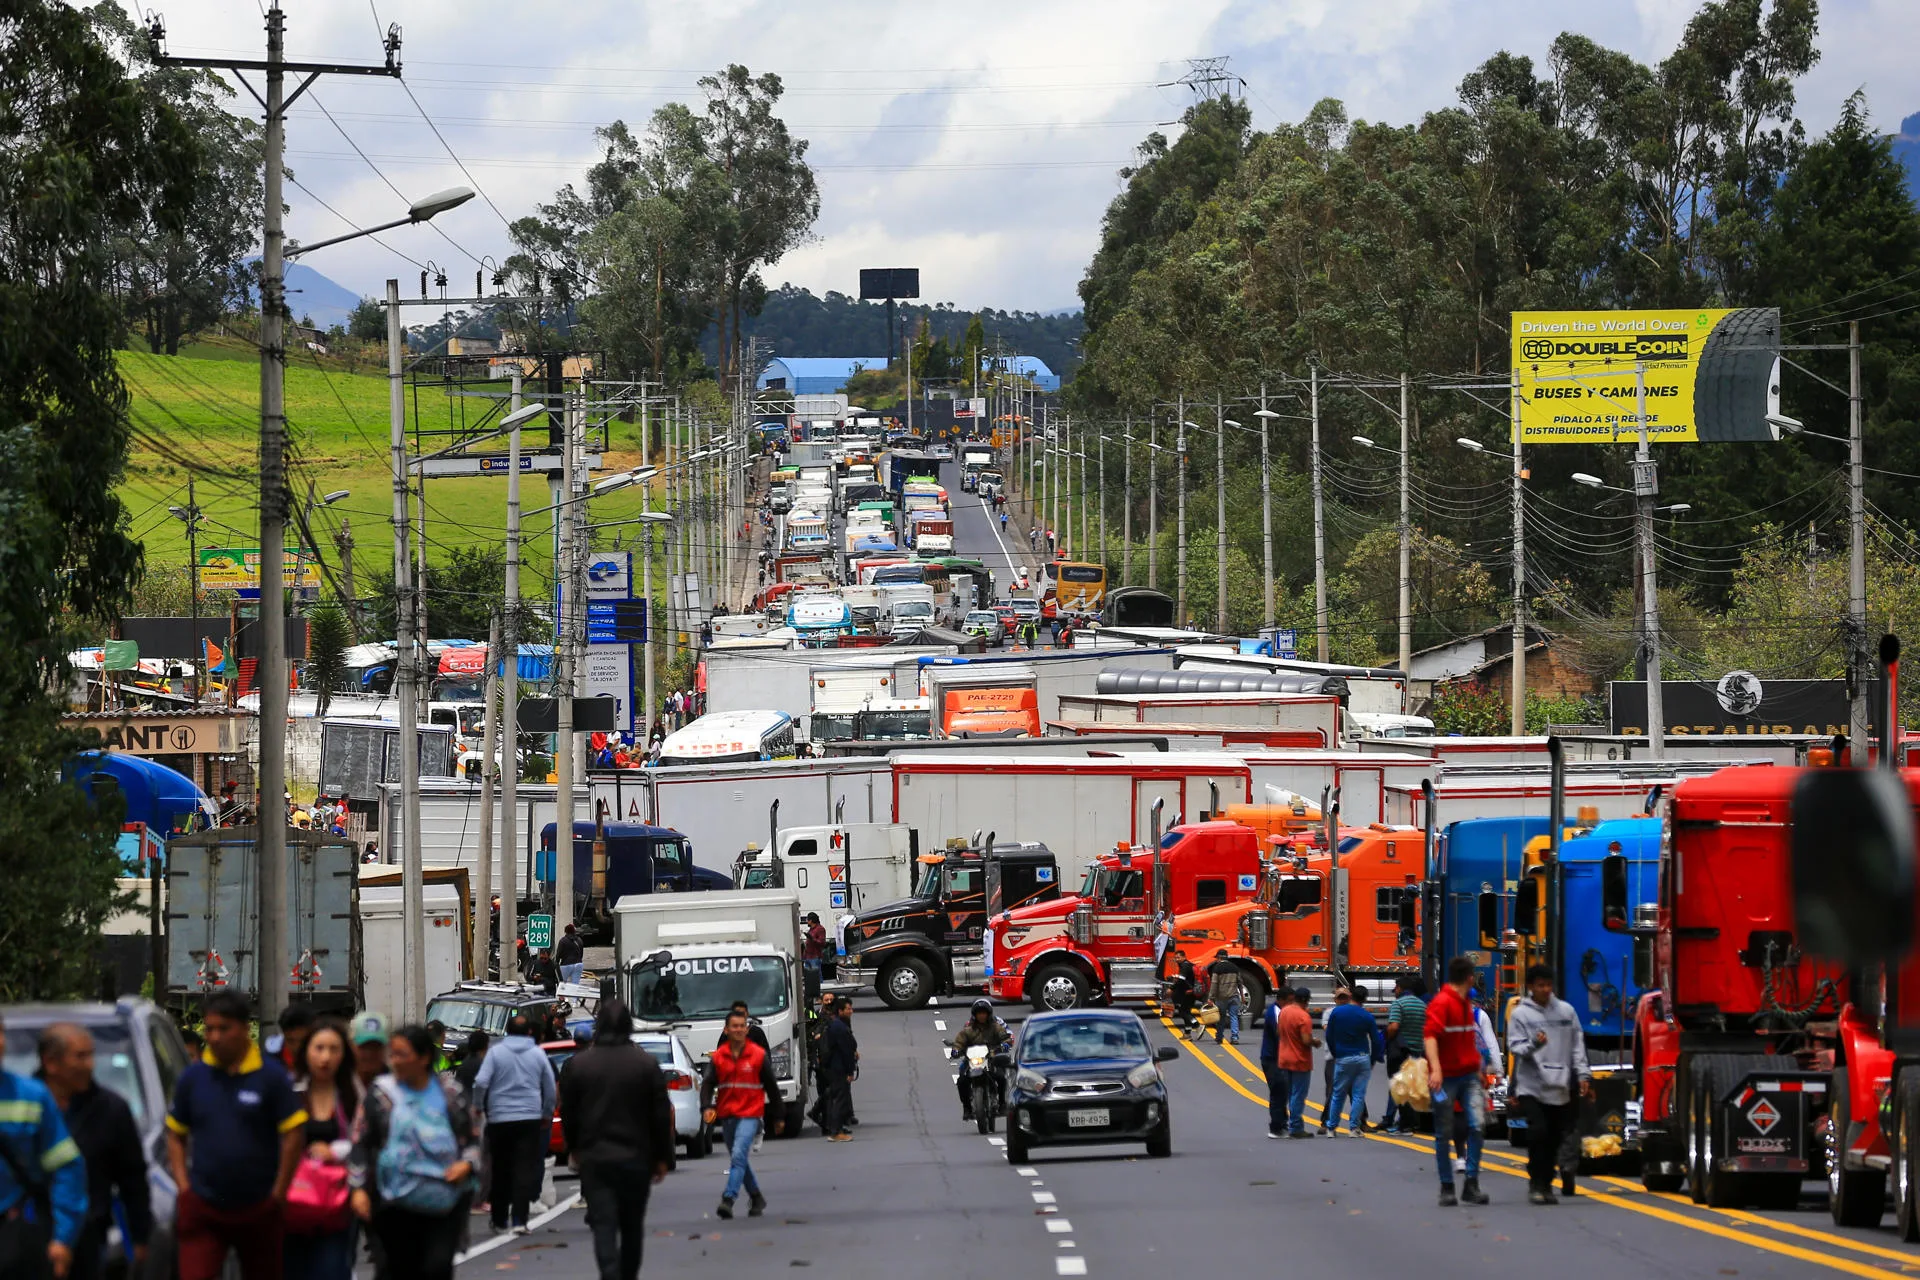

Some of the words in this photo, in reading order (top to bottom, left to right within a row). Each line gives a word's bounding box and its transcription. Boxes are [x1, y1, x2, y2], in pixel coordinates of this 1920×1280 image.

[1520, 321, 1569, 333] Driven
[1573, 320, 1596, 332] the
[1601, 319, 1646, 332] World
[1650, 318, 1688, 331] Over
[1555, 339, 1688, 355] DOUBLECOIN
[1534, 387, 1582, 399] BUSES
[1586, 387, 1597, 398] Y
[1605, 414, 1618, 423] SU
[1525, 426, 1610, 435] DISTRIBUIDORES
[531, 919, 548, 929] km
[530, 932, 549, 943] 289
[660, 957, 755, 977] POLICIA
